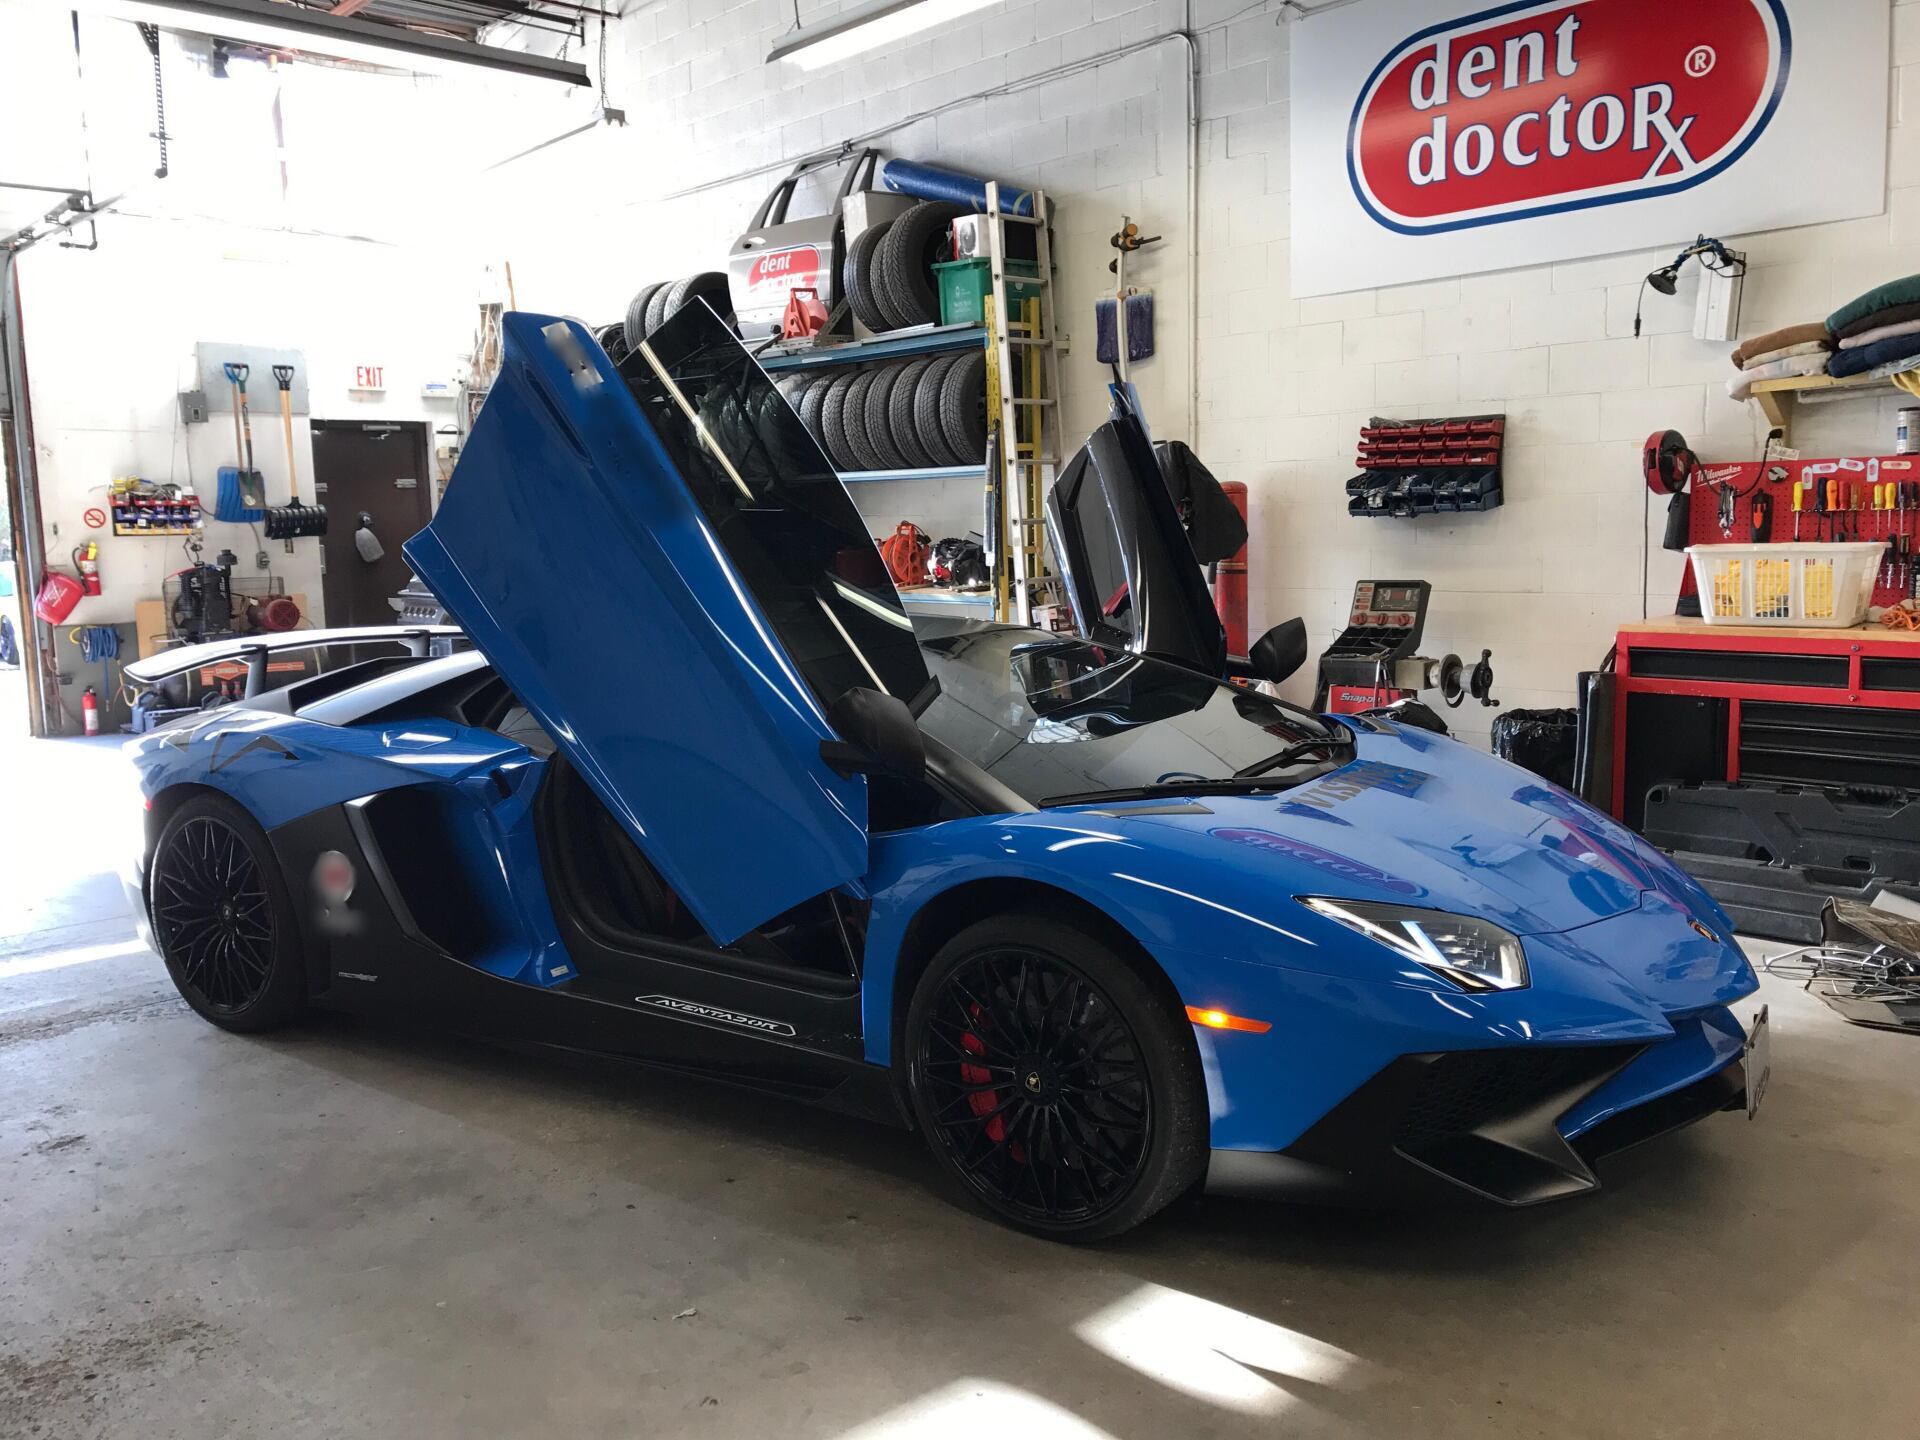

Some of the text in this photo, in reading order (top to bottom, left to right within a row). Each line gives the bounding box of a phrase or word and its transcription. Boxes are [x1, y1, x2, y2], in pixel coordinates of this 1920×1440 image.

[1409, 14, 1581, 111] dent
[759, 253, 792, 274] dent
[356, 365, 383, 388] EXIT
[1695, 464, 1742, 483] Milwaukee
[1339, 692, 1380, 704] Snap-o
[655, 999, 778, 1030] AVENTADOR
